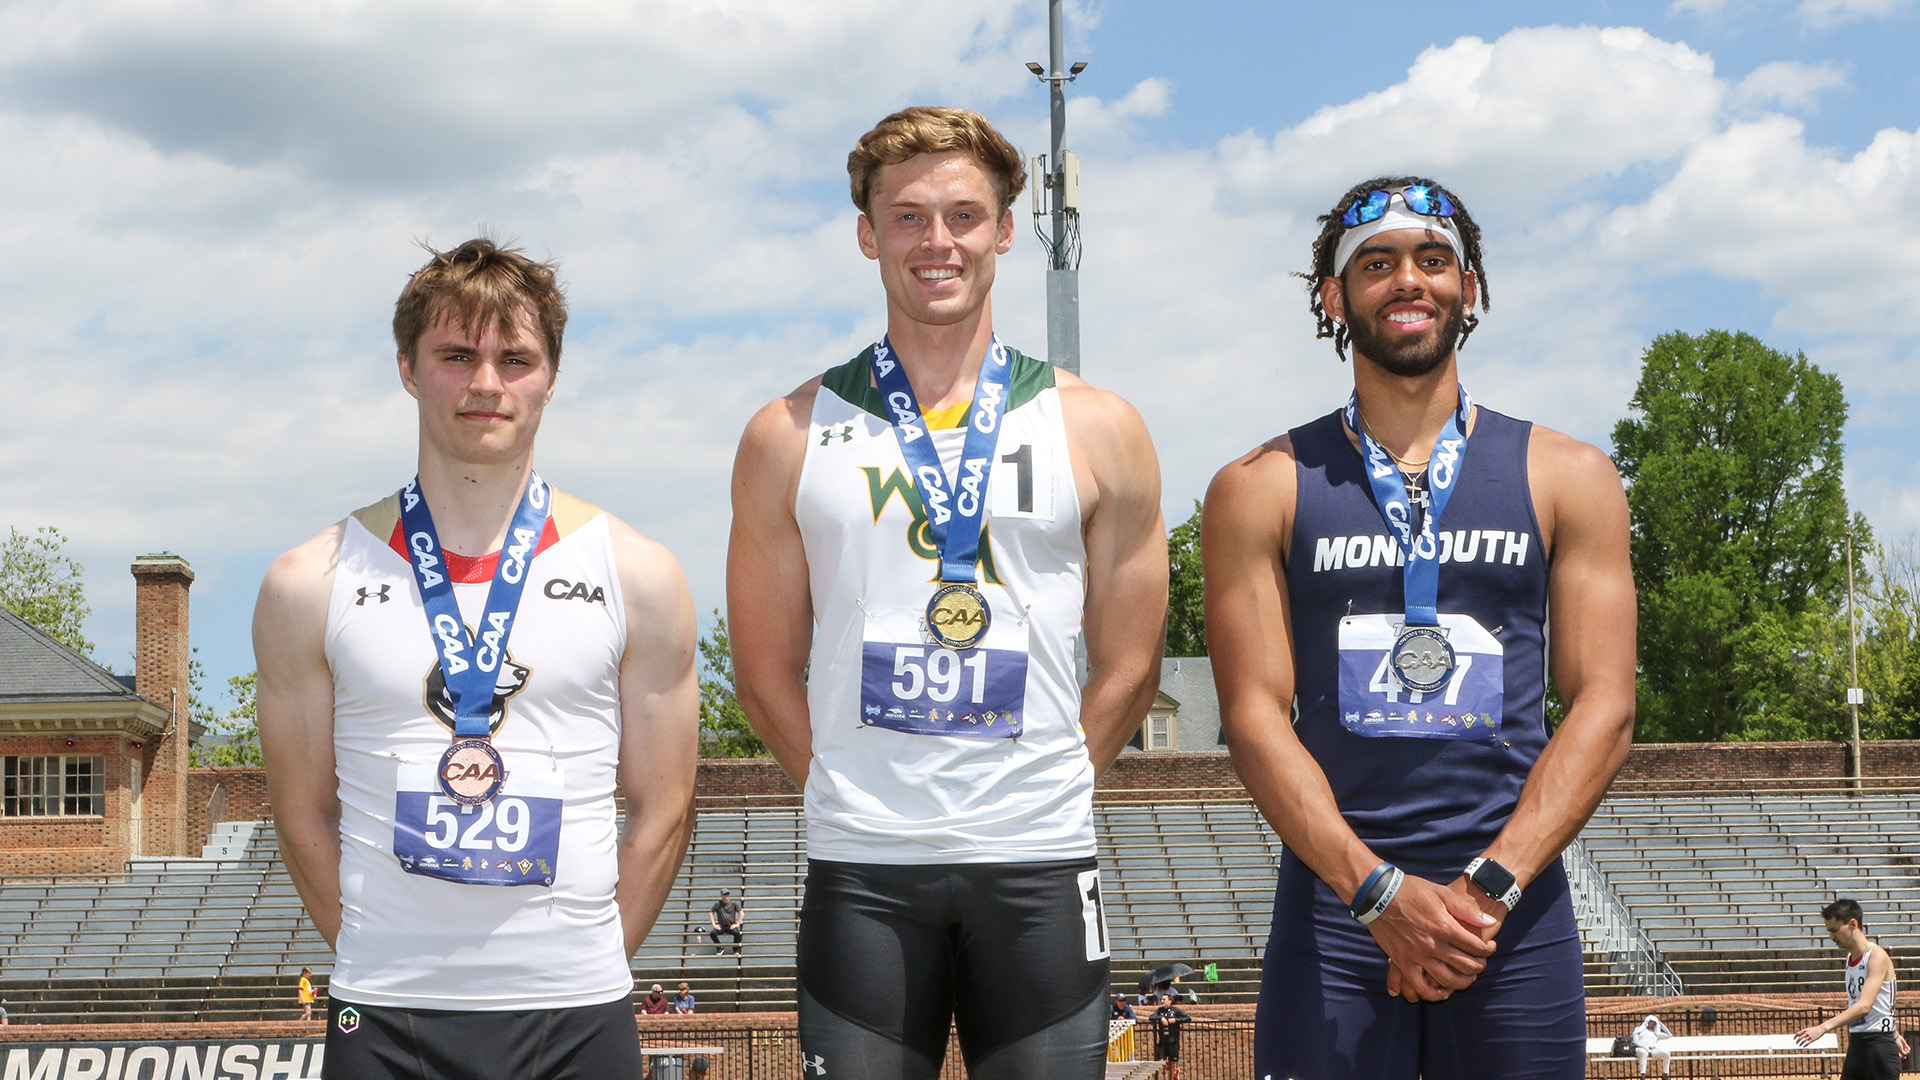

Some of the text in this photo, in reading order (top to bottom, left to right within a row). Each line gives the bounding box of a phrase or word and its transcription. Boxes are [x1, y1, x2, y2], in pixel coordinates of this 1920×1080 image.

[888, 391, 924, 444] CAA
[974, 382, 1004, 434] CAA
[957, 457, 987, 518] CAA
[1002, 444, 1033, 513] 1
[1432, 439, 1463, 490] CAA
[917, 465, 952, 526] CAA
[410, 531, 444, 590] CAA
[501, 527, 536, 585] CAA
[544, 578, 607, 606] CAA
[930, 606, 988, 626] CAA
[434, 613, 469, 675] CAA
[476, 611, 510, 673] CAA
[1395, 651, 1453, 669] CAA
[891, 646, 987, 704] 591
[1369, 652, 1472, 705] 47
[441, 763, 500, 781] CAA
[222, 847, 227, 855] S
[424, 795, 530, 852] 529
[1086, 876, 1106, 953] 1
[1581, 893, 1587, 901] M
